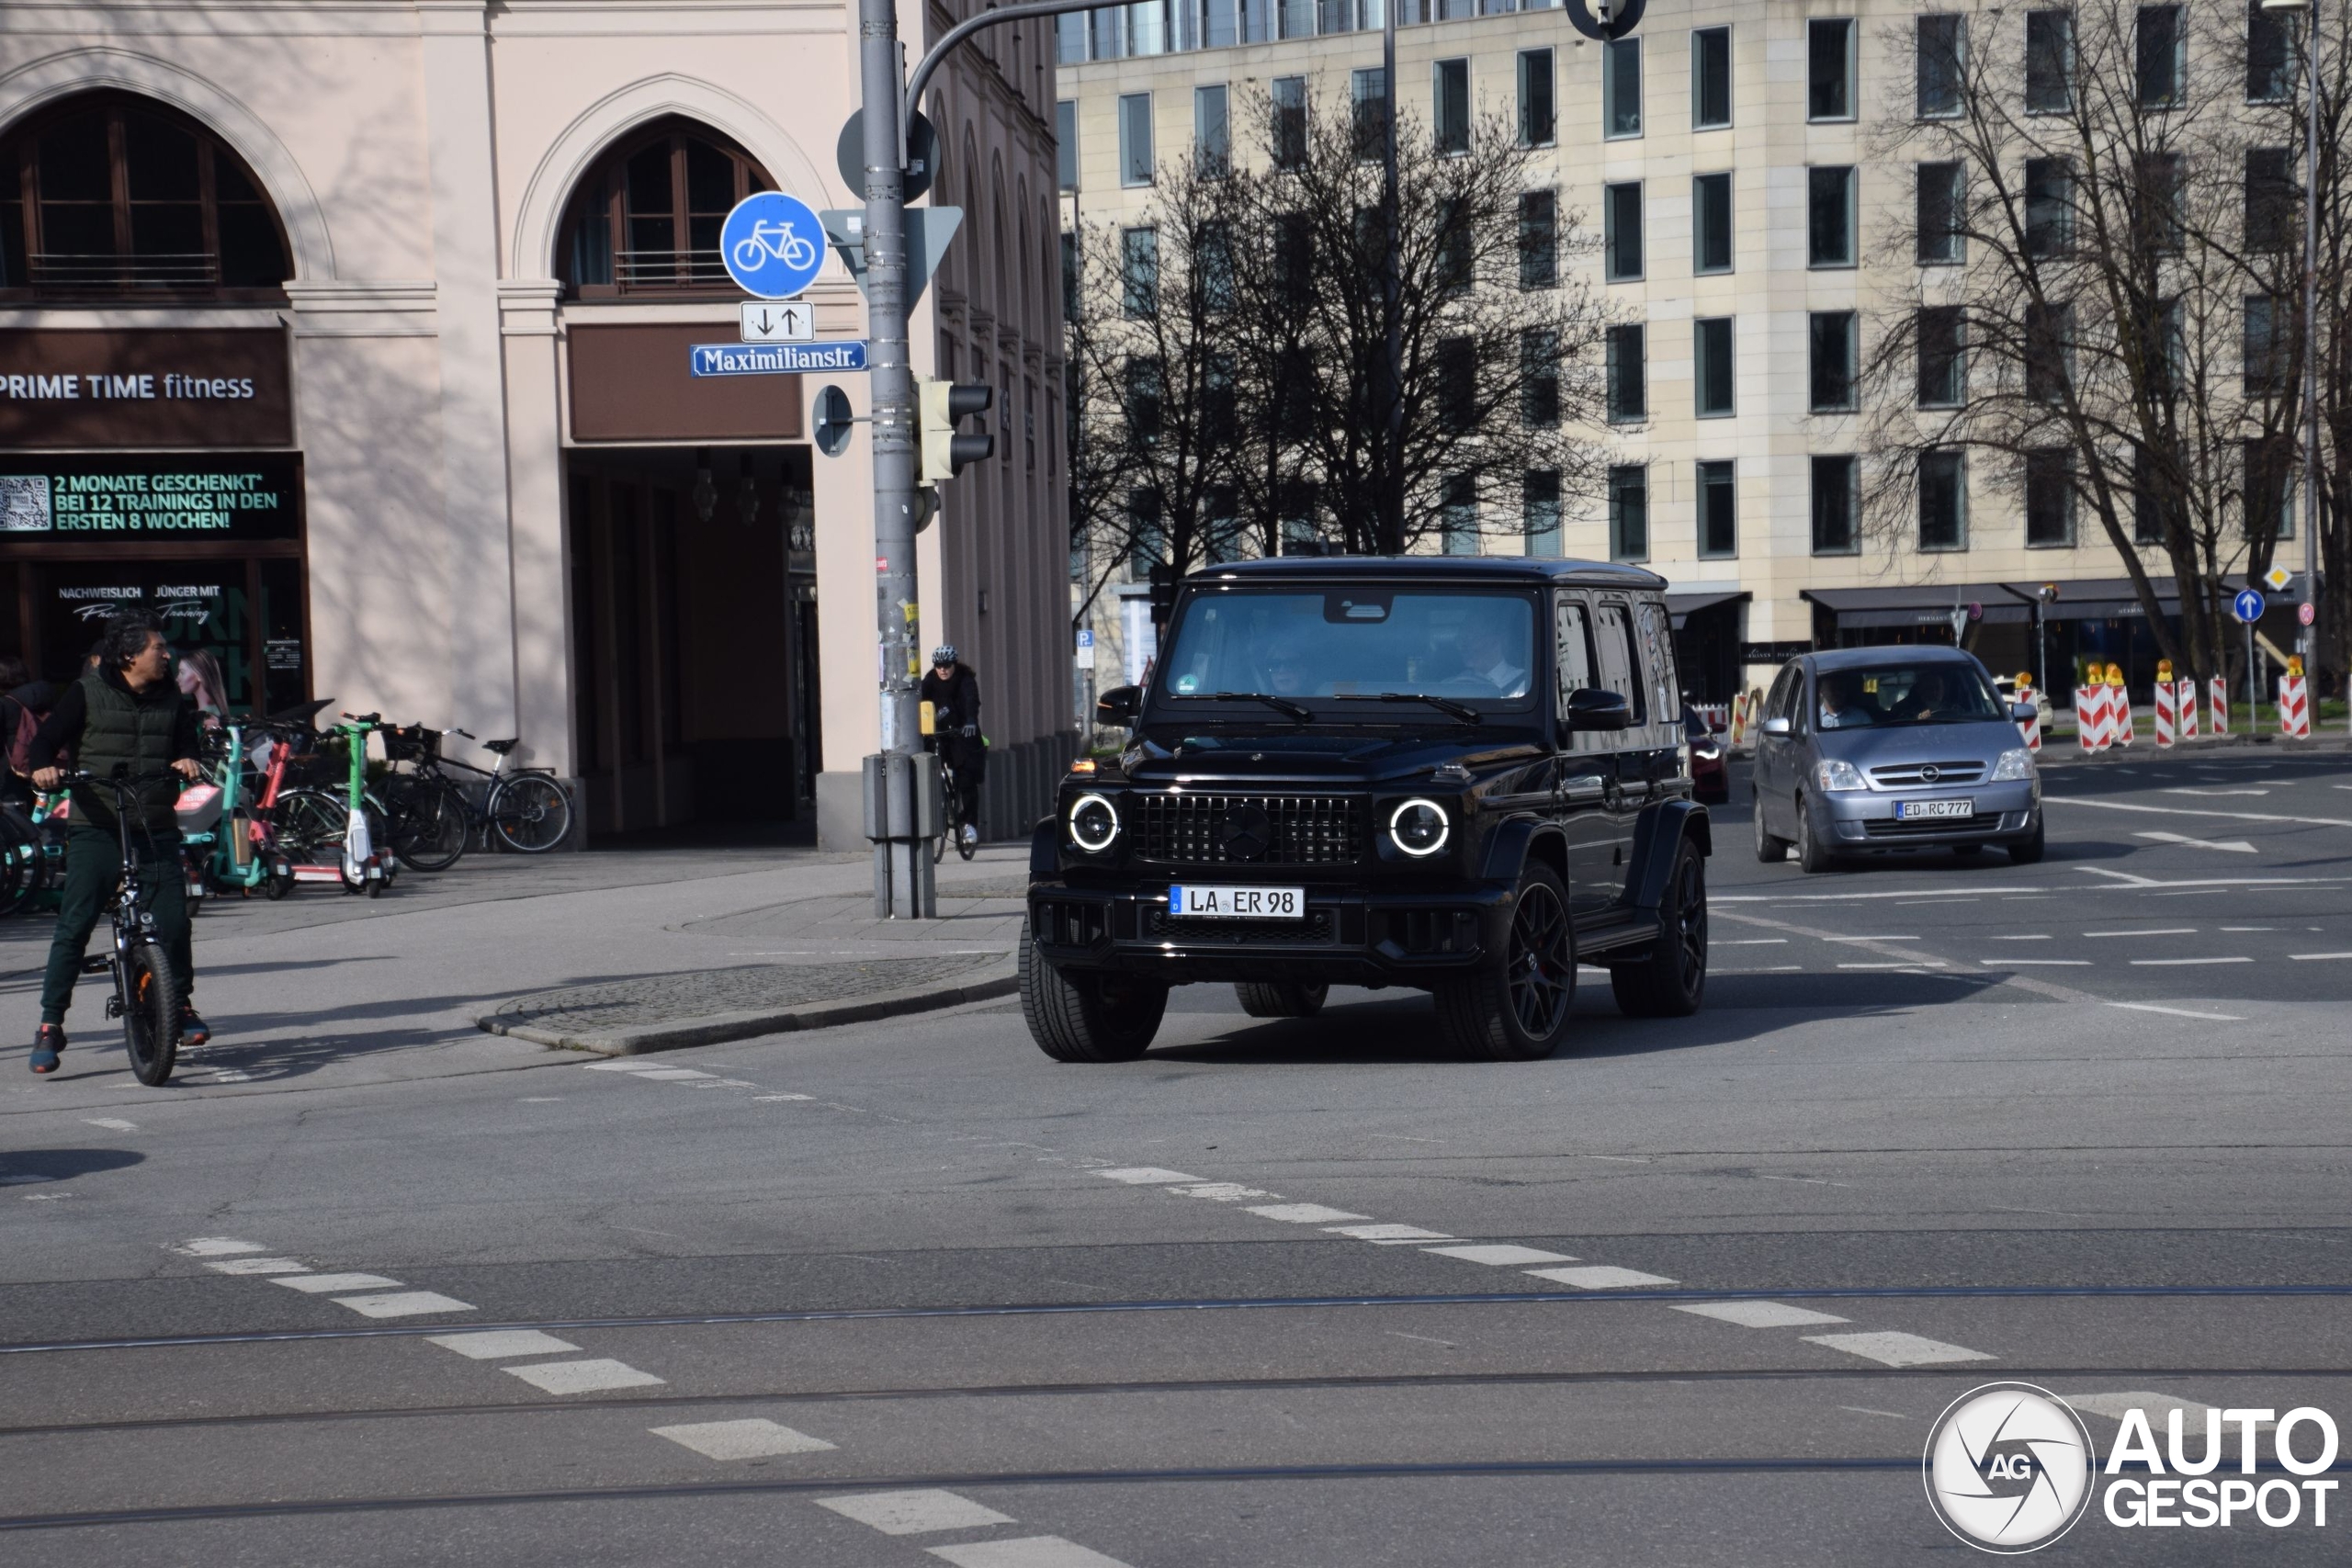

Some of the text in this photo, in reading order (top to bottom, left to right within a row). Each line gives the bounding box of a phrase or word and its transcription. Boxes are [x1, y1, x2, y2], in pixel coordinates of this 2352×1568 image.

[705, 348, 856, 372] Maximilianstr.
[85, 375, 155, 399] TIME
[164, 374, 254, 399] fitness
[54, 476, 66, 492] 2
[70, 475, 148, 492] MONATE
[56, 492, 277, 511] BEI 12 TRAININGS IN DEN
[56, 512, 231, 530] ERSTEN 8 WOCHEN!
[59, 587, 141, 598] NACHWEISLICH
[154, 585, 220, 597] JÜNGER MIT
[156, 601, 209, 625] Training
[1905, 805, 1921, 816] ED
[1928, 803, 1945, 815] RC
[1948, 802, 1970, 814] 777
[1191, 890, 1218, 912] LA
[1234, 891, 1261, 913] ER
[1268, 892, 1295, 913] 98
